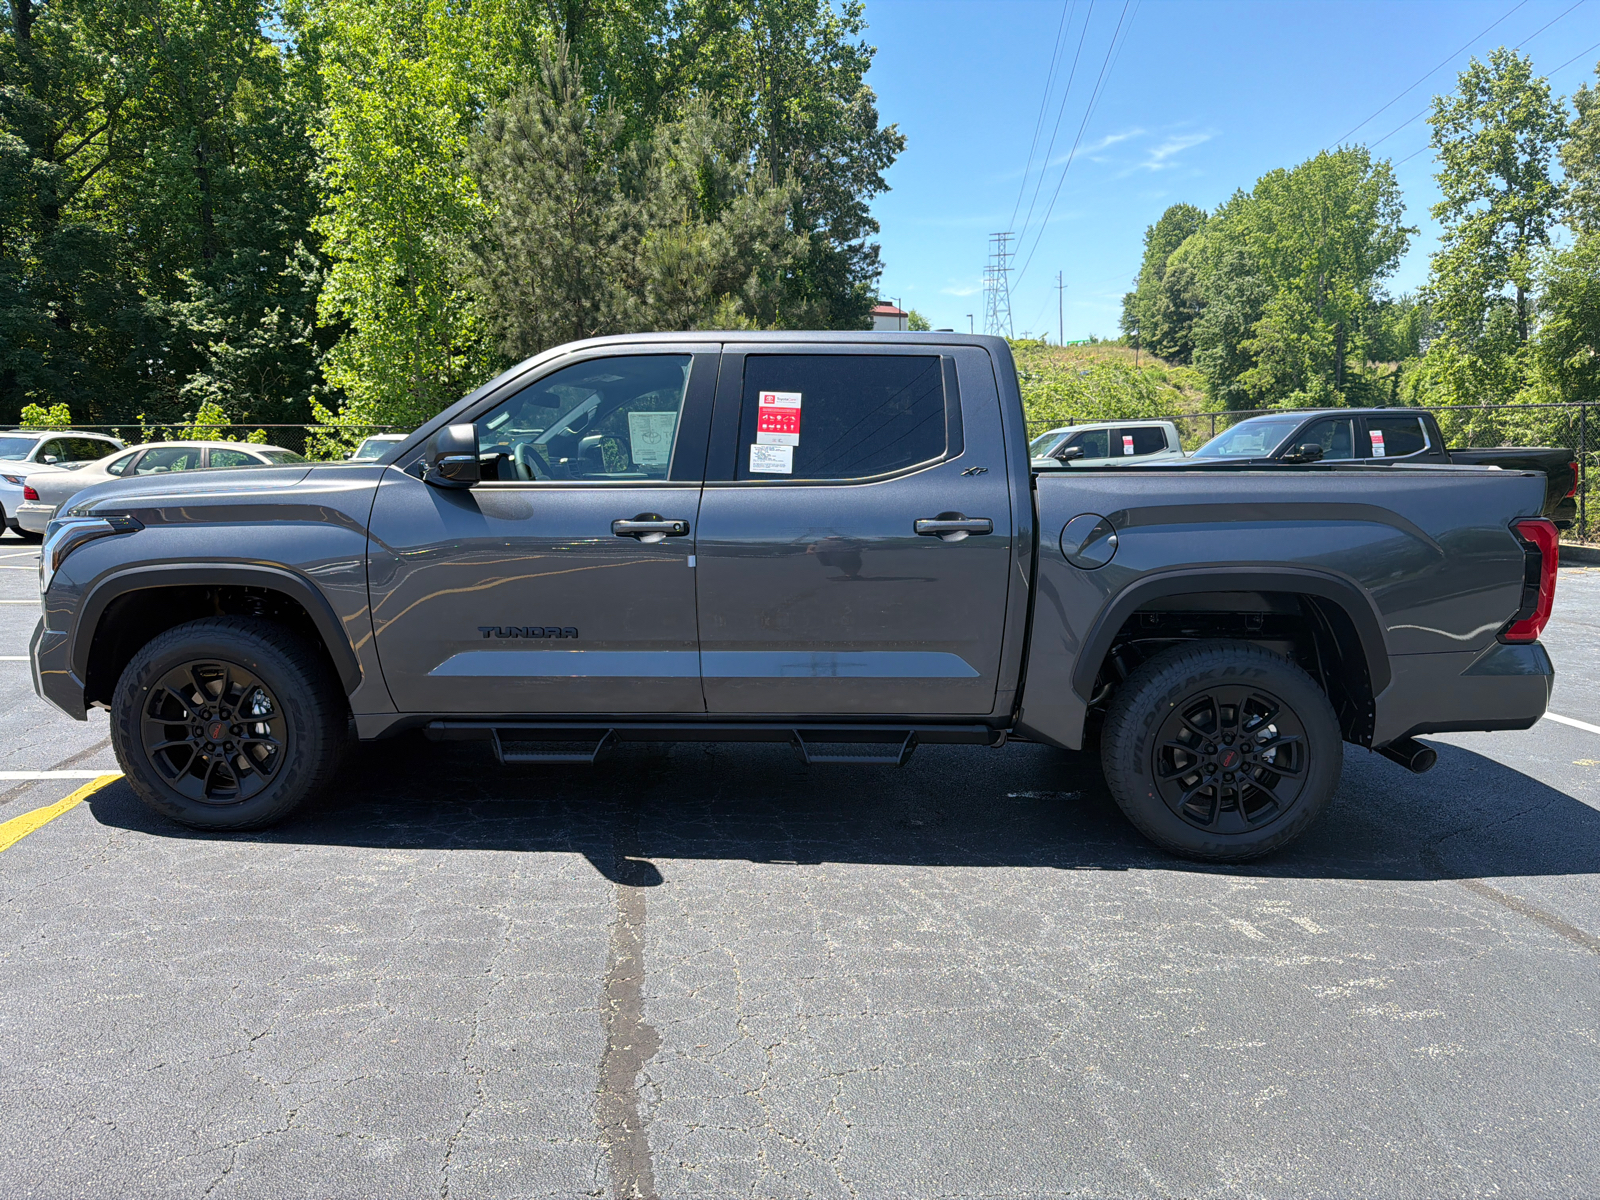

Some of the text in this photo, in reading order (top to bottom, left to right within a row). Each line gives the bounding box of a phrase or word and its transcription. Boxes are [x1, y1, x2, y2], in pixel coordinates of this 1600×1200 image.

[477, 626, 579, 638] TUNDRA
[1132, 666, 1268, 774] WILDPEAK A/T
[213, 723, 222, 739] TRD
[1223, 751, 1235, 767] TRD
